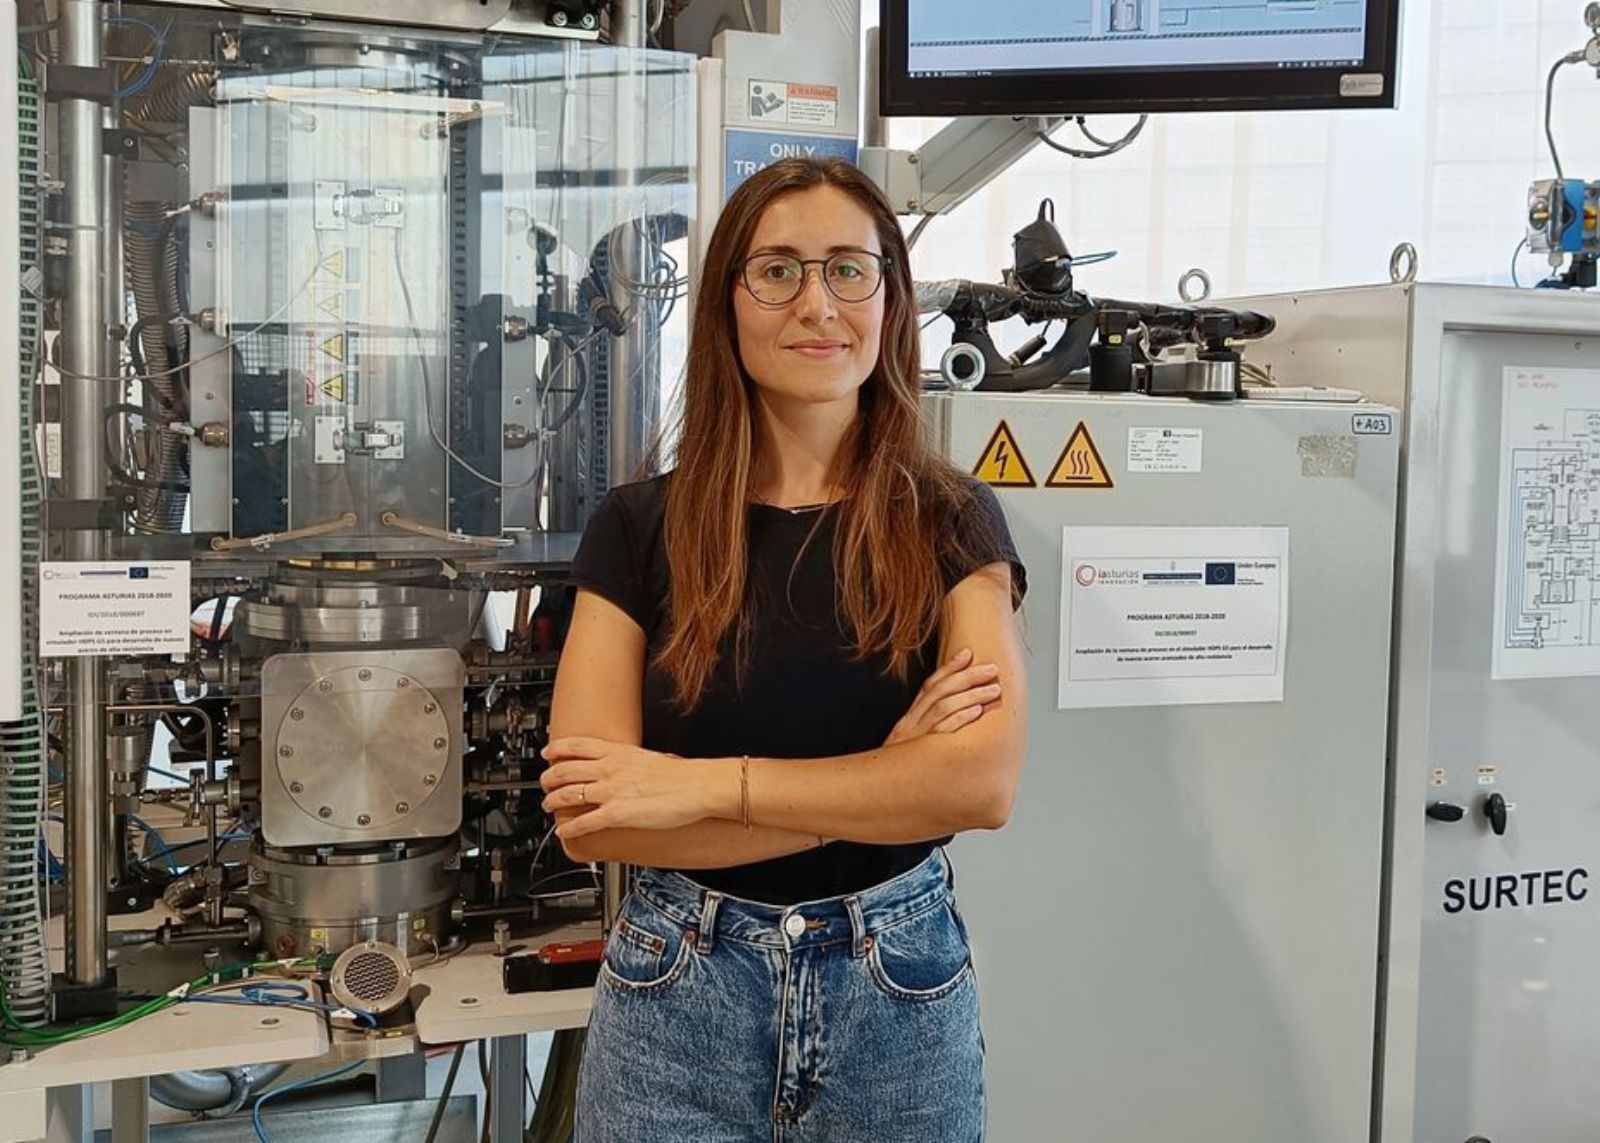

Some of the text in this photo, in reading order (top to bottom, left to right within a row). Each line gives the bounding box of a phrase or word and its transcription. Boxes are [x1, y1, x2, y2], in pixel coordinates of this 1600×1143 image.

[770, 143, 815, 158] ONLY
[1127, 613, 1163, 621] PROGRAMA
[1164, 613, 1194, 621] ASTURIAS
[1443, 868, 1588, 913] SURTEC
